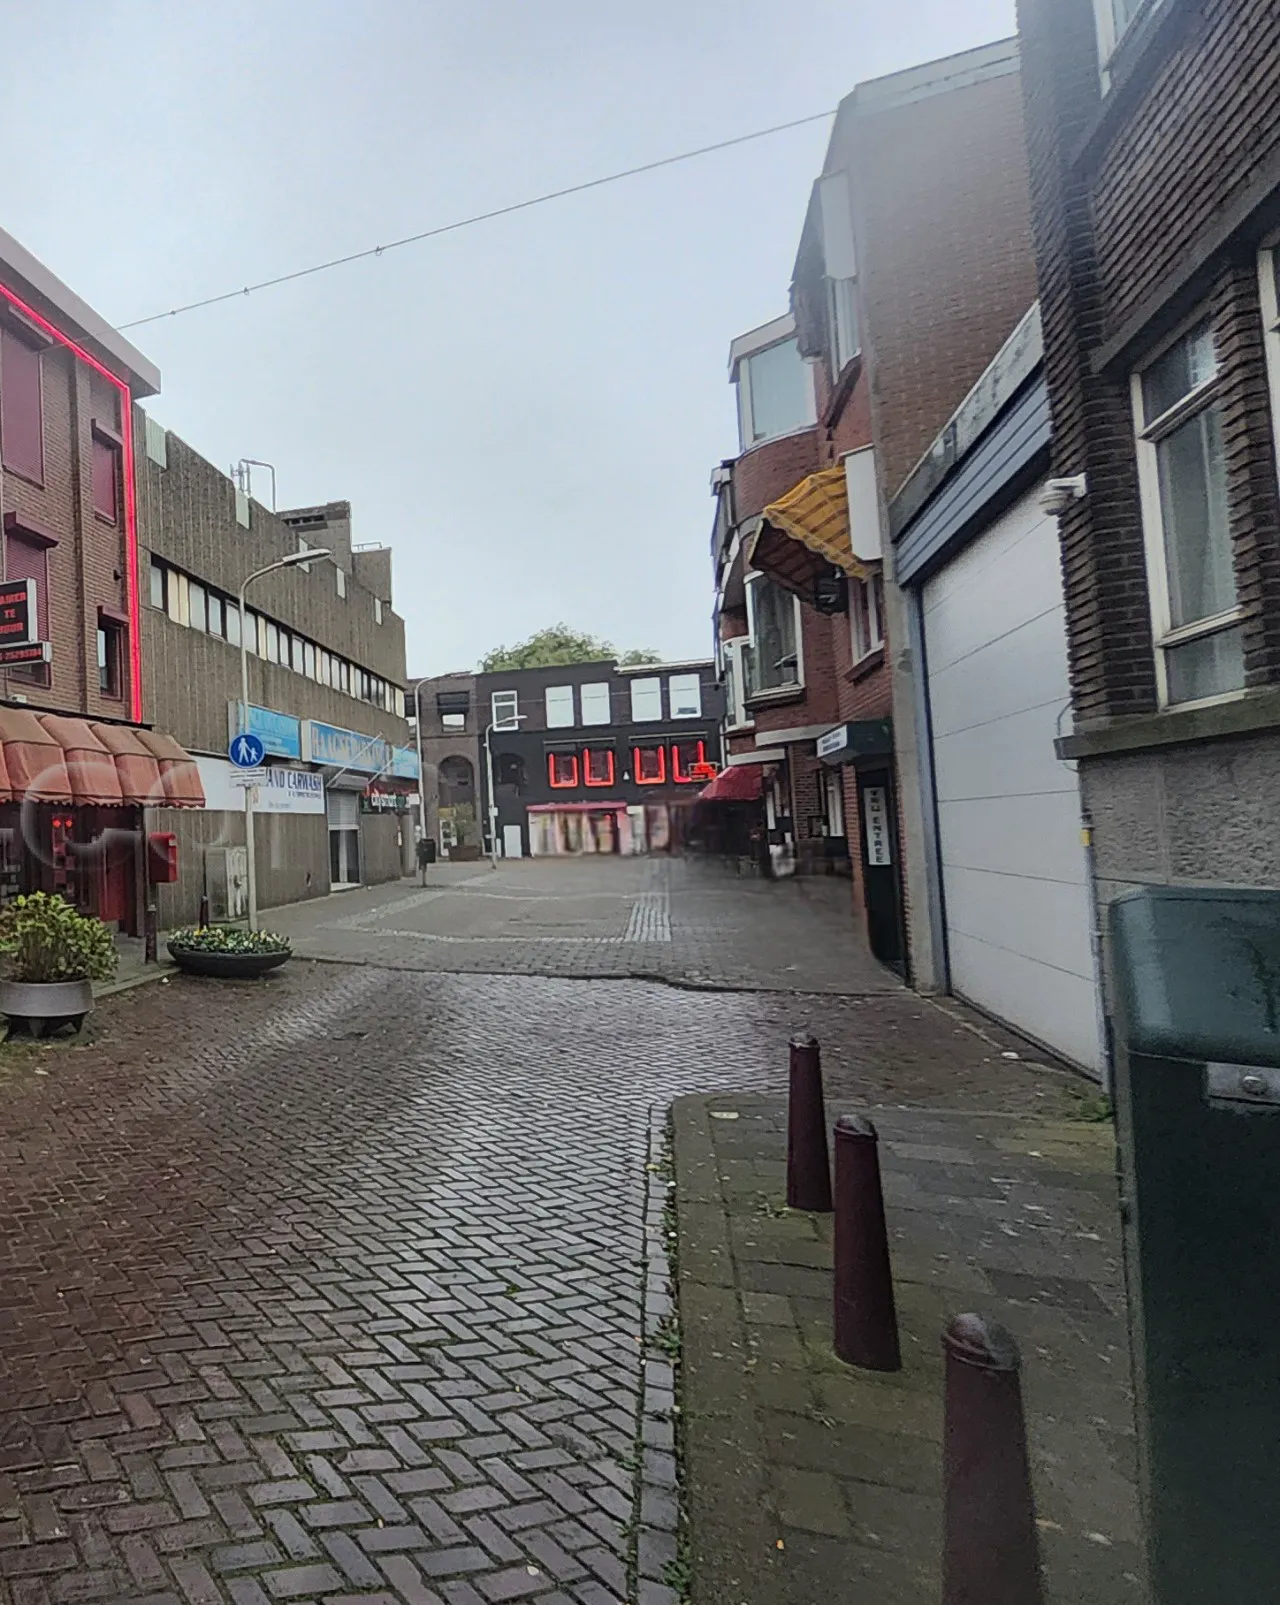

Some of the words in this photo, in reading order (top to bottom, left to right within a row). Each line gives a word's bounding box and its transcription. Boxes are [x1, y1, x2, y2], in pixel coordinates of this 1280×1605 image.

[4, 608, 16, 619] TE
[266, 766, 285, 788] AND
[287, 771, 322, 791] CARWASH
